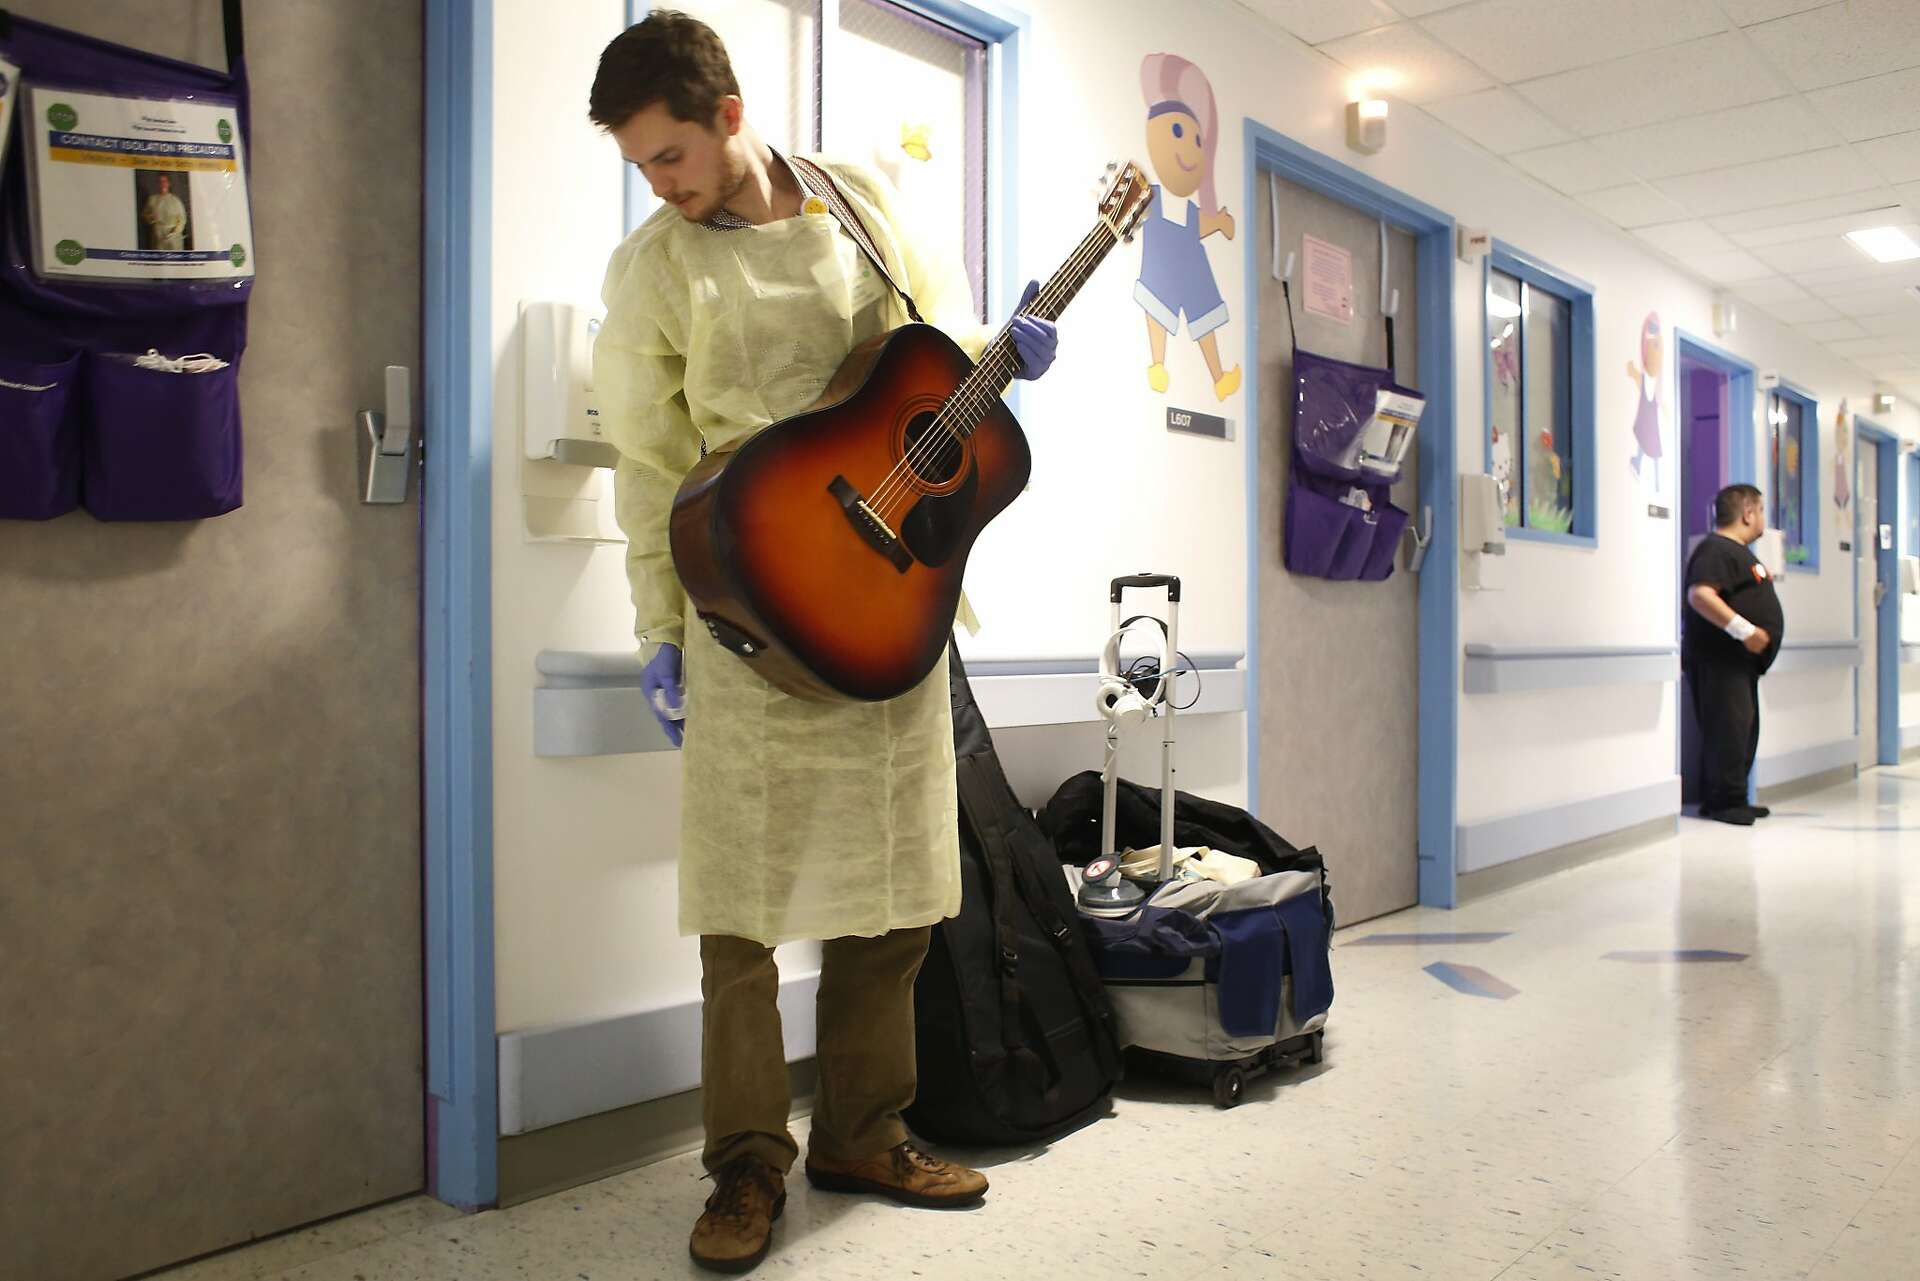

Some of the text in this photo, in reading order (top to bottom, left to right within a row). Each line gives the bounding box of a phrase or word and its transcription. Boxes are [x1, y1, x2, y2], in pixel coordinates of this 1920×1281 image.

[61, 134, 117, 148] CONTACT
[121, 139, 176, 152] ISOLATION
[1170, 411, 1192, 427] L607
